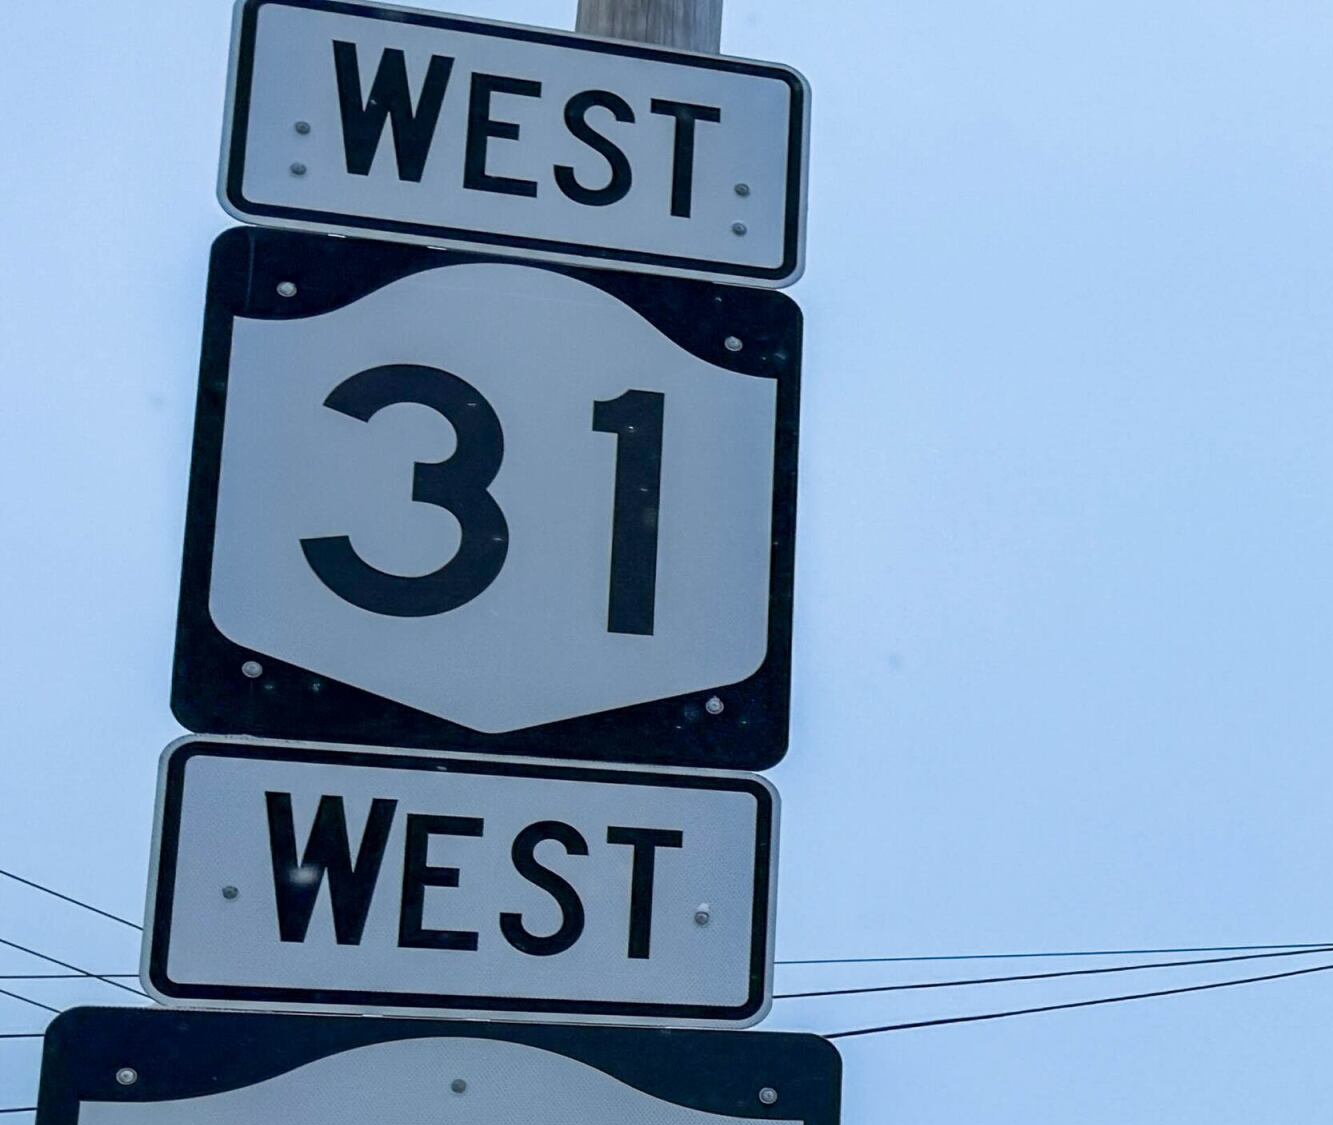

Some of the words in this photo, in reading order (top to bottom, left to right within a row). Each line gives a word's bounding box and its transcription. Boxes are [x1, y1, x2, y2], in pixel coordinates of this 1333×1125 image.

[332, 40, 722, 218] WEST
[300, 363, 666, 637] 31
[265, 791, 684, 959] WEST
